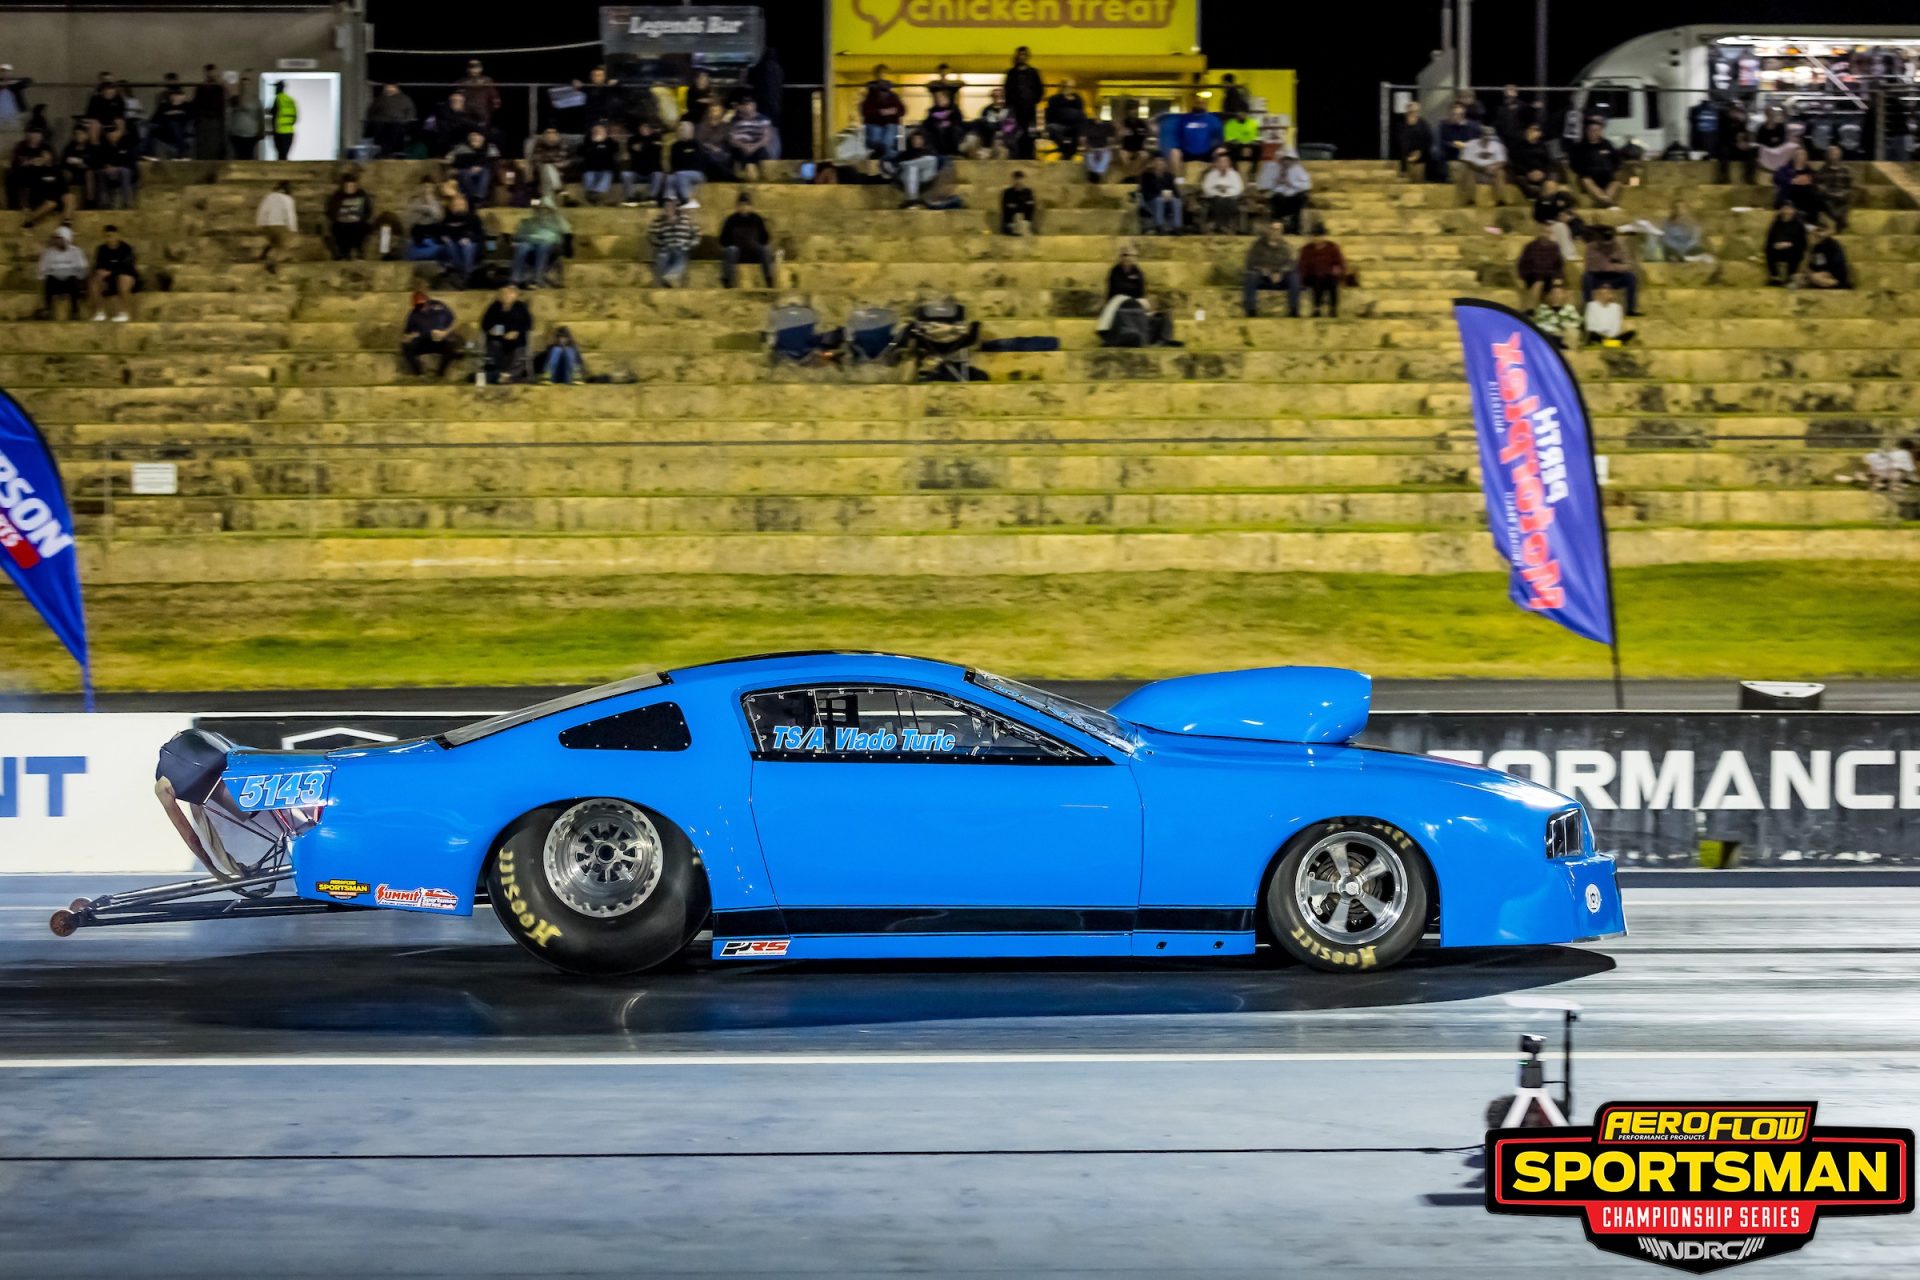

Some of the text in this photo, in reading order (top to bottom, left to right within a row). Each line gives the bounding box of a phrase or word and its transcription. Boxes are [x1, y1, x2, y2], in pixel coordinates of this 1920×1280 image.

[628, 16, 744, 38] Legends Bar
[773, 726, 956, 751] TS/A Vlado Turic
[239, 771, 326, 808] 5143
[318, 883, 368, 892] SPORTSMAN
